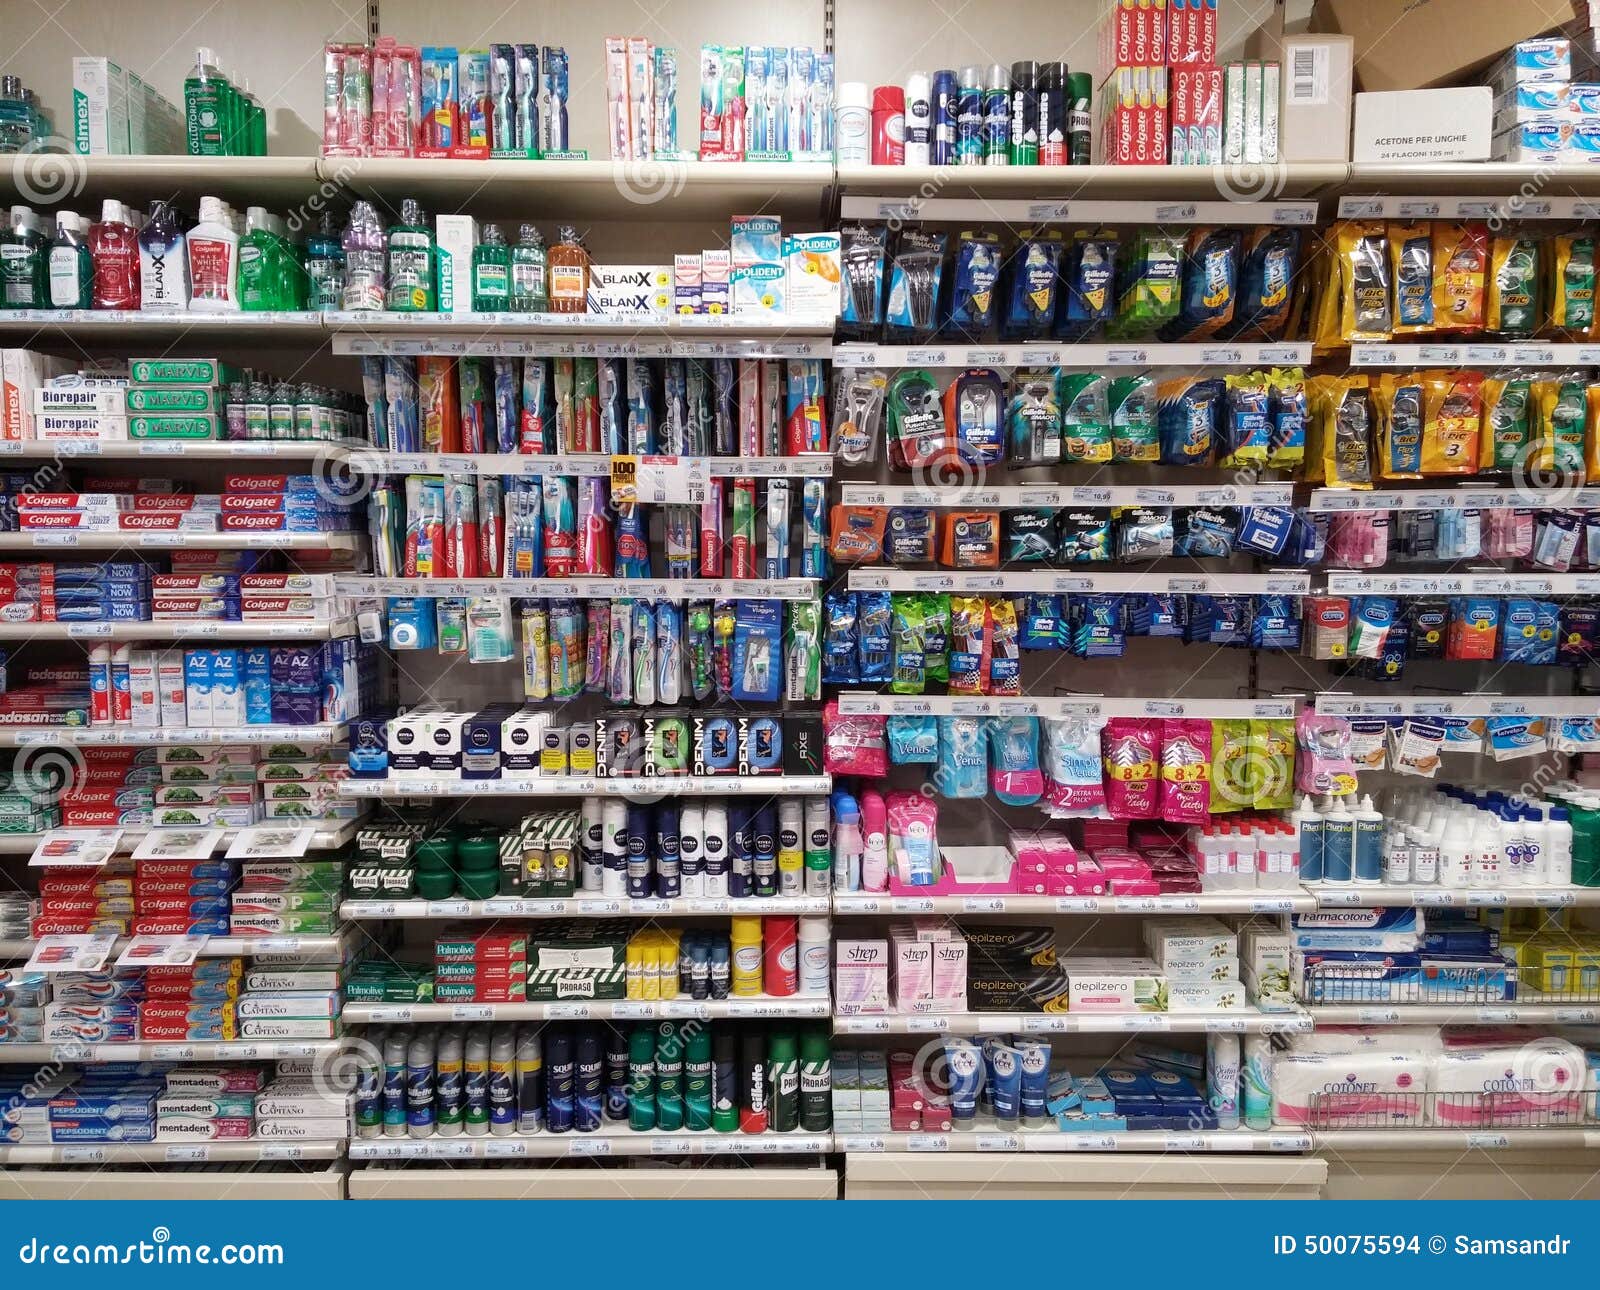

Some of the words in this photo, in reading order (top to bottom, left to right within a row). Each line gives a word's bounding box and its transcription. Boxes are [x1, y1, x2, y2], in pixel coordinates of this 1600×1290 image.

[1119, 13, 1129, 62] Colgate
[1135, 13, 1145, 62] Colgate
[1151, 13, 1161, 62] Colgate
[1170, 13, 1180, 62] Colgate
[1186, 13, 1196, 62] Colgate
[1202, 13, 1212, 63] Colgate
[1178, 72, 1188, 122] Colgate
[1194, 72, 1204, 123] Colgate
[1210, 71, 1220, 121] Colgate
[1013, 92, 1023, 144] Gillette
[79, 97, 88, 153] elmex
[1120, 111, 1129, 161] Colgate
[1136, 111, 1145, 161] Colgate
[1152, 111, 1162, 161] Colgate
[1375, 137, 1413, 146] ACETONE
[1435, 135, 1466, 143] UNGHIE
[734, 223, 778, 231] POLIDENT
[793, 240, 837, 250] POLIDENT
[736, 267, 783, 278] POLIDENT
[442, 256, 451, 309] elmex
[1454, 299, 1464, 312] 3
[154, 366, 210, 378] MARVIS
[43, 392, 96, 403] Biorepair
[151, 394, 205, 406] MARVIS
[10, 390, 20, 437] elmex
[904, 413, 934, 421] Gillette
[45, 418, 99, 429] Biorepair
[966, 428, 995, 436] Gillette
[1446, 444, 1459, 456] 3
[612, 462, 634, 474] 100
[229, 477, 280, 488] Colgate
[26, 495, 70, 506] Colgate
[688, 489, 704, 502] 1.99
[138, 497, 188, 508] Colgate
[224, 496, 277, 507] Colgate
[28, 515, 73, 525] Colgate
[123, 515, 177, 525] Colgate
[226, 515, 278, 525] Colgate
[1196, 512, 1226, 524] Gillette
[1254, 510, 1283, 525] Gillette
[895, 538, 922, 546] Gillette
[156, 577, 197, 586] Colgate
[243, 577, 285, 586] Colgate
[112, 589, 134, 597] NOW
[155, 600, 197, 609] Colgate
[244, 599, 286, 609] Colgate
[112, 608, 134, 617] NOW
[752, 606, 775, 614] Viaggio
[189, 657, 207, 667] AZ
[214, 657, 232, 667] AZ
[247, 655, 265, 665] AZ
[292, 656, 309, 667] AZ
[597, 720, 606, 777] DENIM
[646, 720, 655, 776] DENIM
[694, 719, 703, 776] DENIM
[739, 719, 748, 775] DENIM
[799, 732, 807, 758] AXE
[900, 745, 929, 754] Venus
[953, 753, 982, 765] Venus
[64, 793, 110, 802] Colgate
[68, 811, 113, 820] Colgate
[141, 900, 186, 909] Colgate
[234, 918, 279, 926] mentadent
[1304, 913, 1373, 922] Farmacotone
[38, 924, 84, 933] Colgate
[136, 923, 184, 933] Colgate
[964, 935, 1015, 944] depilzero
[438, 945, 475, 956] Palmolive
[847, 946, 877, 961] strep
[938, 948, 964, 960] strep
[438, 966, 475, 976] Palmolive
[347, 987, 384, 996] Palmolive
[560, 983, 591, 992] PRORASO
[974, 981, 1027, 991] depilzero
[1074, 982, 1127, 992] depilzero
[1172, 988, 1210, 996] depilzero
[144, 1008, 184, 1017] Colgate
[840, 1003, 860, 1013] strep
[144, 1026, 184, 1035] Colgate
[170, 1079, 219, 1087] mentadent
[752, 1064, 762, 1111] Gillette
[1324, 1083, 1376, 1093] COTONET
[1484, 1080, 1535, 1091] COTONET
[54, 1107, 104, 1116] PEPSODENT
[160, 1105, 212, 1113] mentadent
[56, 1127, 106, 1136] PEPSODENT
[160, 1124, 210, 1132] mentadent
